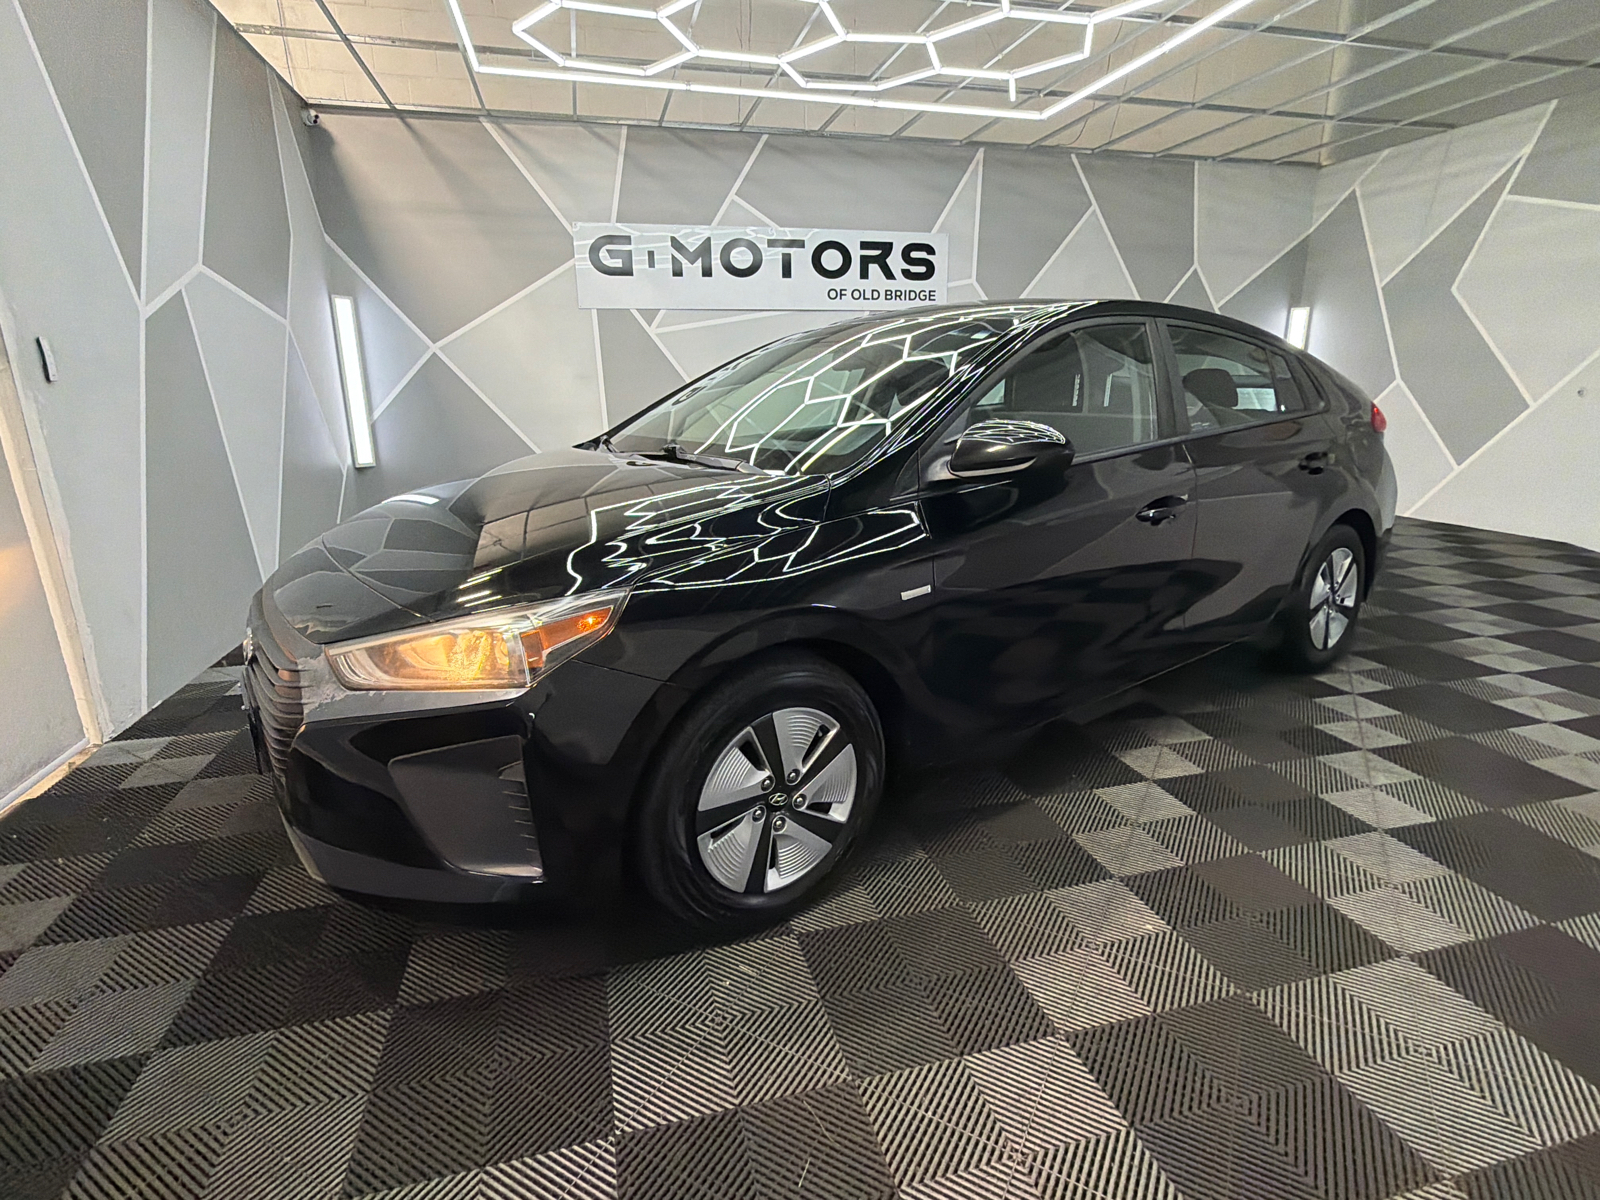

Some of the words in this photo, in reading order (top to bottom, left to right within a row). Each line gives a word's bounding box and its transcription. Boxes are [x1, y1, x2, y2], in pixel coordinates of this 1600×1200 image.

[827, 288, 848, 301] OF
[850, 288, 881, 301] OLD
[884, 289, 937, 302] BRIDGE
